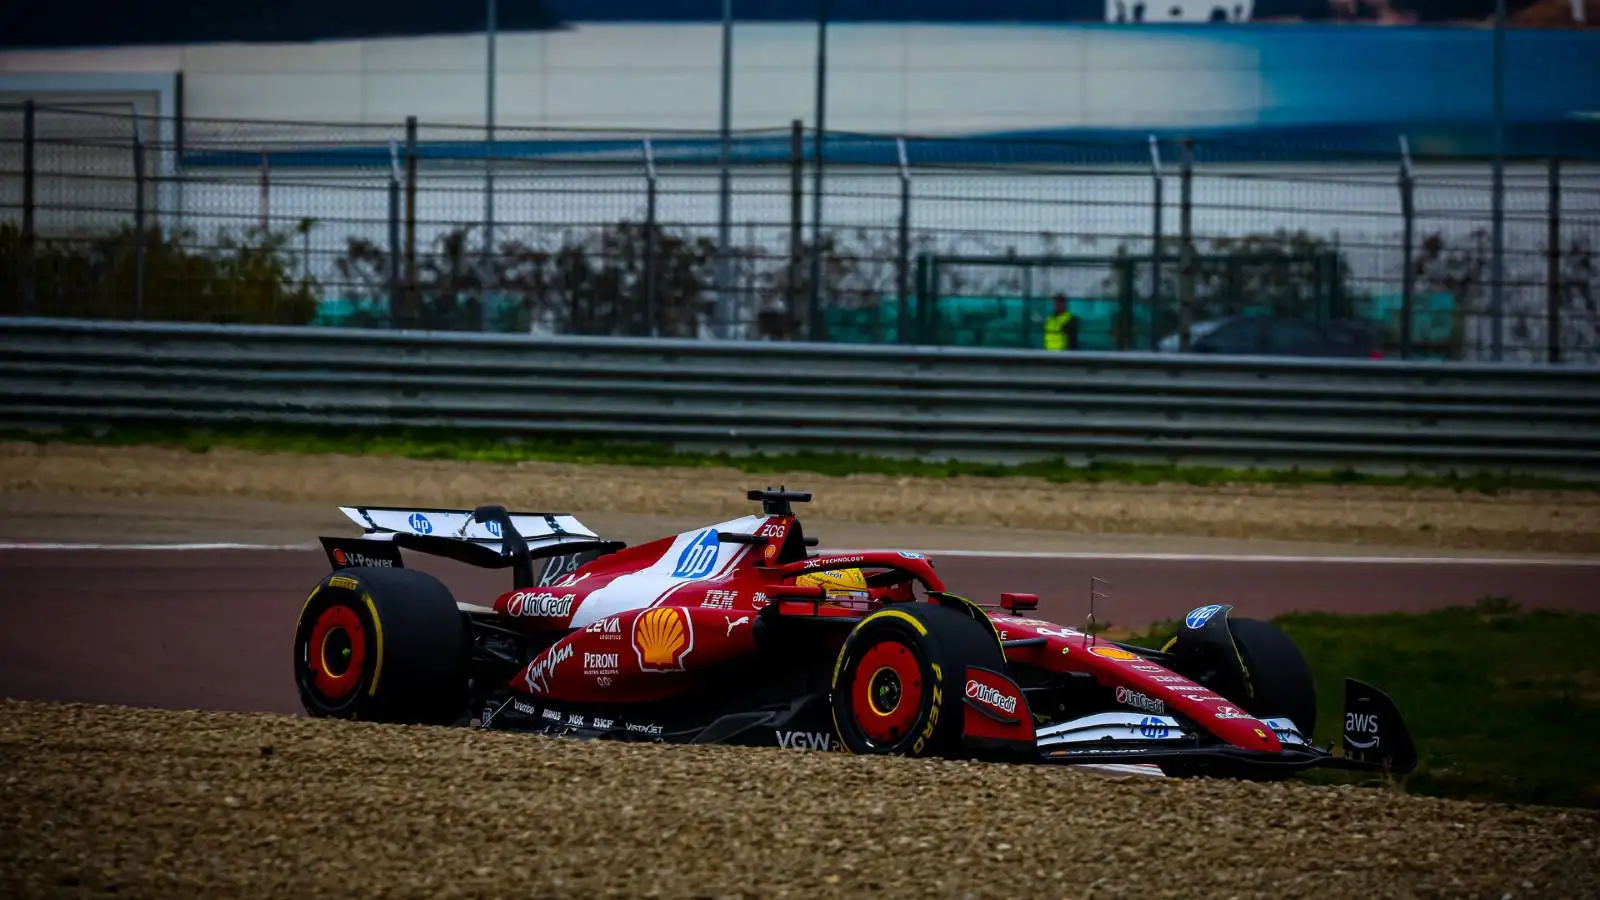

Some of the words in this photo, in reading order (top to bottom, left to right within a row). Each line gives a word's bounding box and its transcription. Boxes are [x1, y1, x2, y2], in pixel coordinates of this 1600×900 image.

[409, 512, 432, 534] hp
[761, 525, 785, 537] ZCG
[344, 552, 393, 568] V-Power
[676, 529, 719, 577] hp
[822, 556, 865, 565] TECHNOLOGY
[521, 593, 576, 617] UniCredit
[700, 589, 739, 609] IBM
[583, 652, 620, 669] PERONI
[976, 684, 1017, 713] UniCredit
[1126, 689, 1165, 714] UniCredit
[593, 717, 615, 729] SKF
[1345, 711, 1379, 734] aws
[776, 730, 831, 752] VGW
